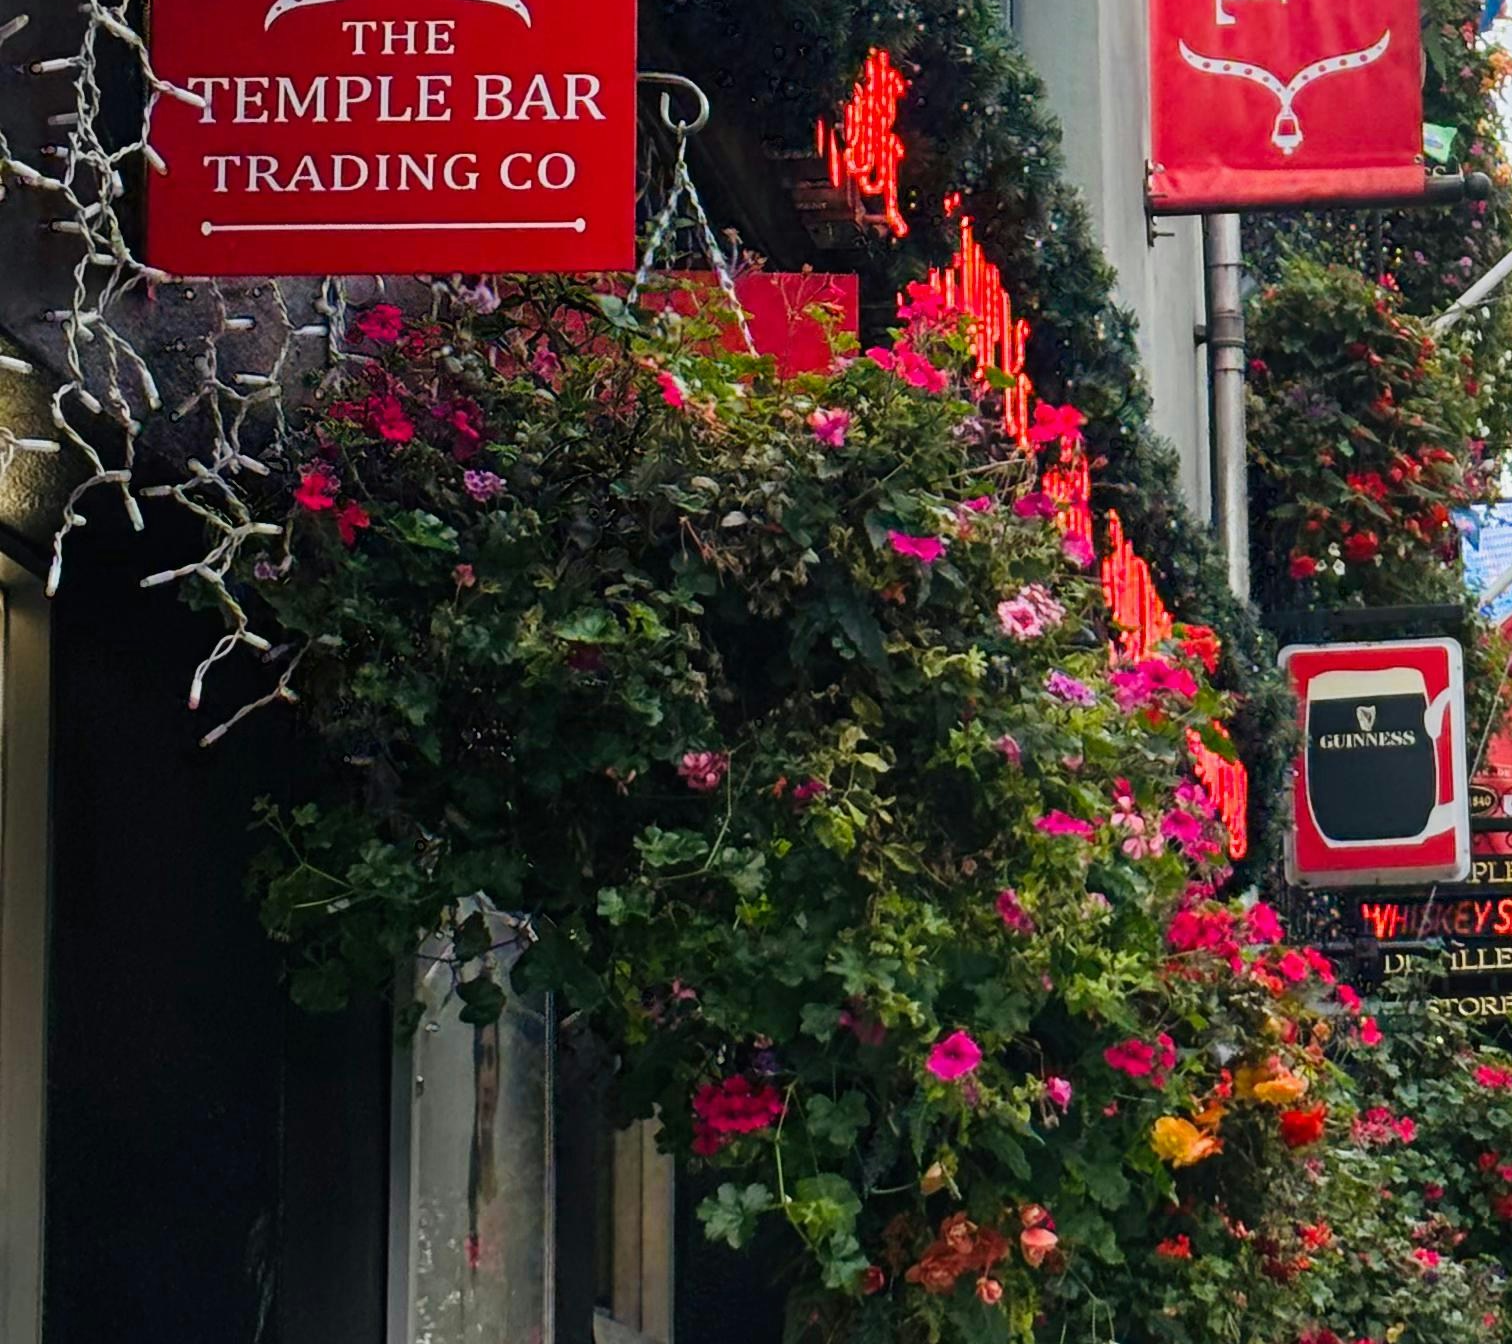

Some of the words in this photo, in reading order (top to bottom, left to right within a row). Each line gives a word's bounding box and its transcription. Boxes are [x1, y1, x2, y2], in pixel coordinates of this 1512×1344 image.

[342, 20, 456, 56] THE
[187, 74, 453, 125] TEMPLE
[473, 72, 607, 122] BAR
[203, 153, 480, 194] TRADING
[499, 151, 577, 191] CO
[1319, 730, 1416, 749] GUINNESS
